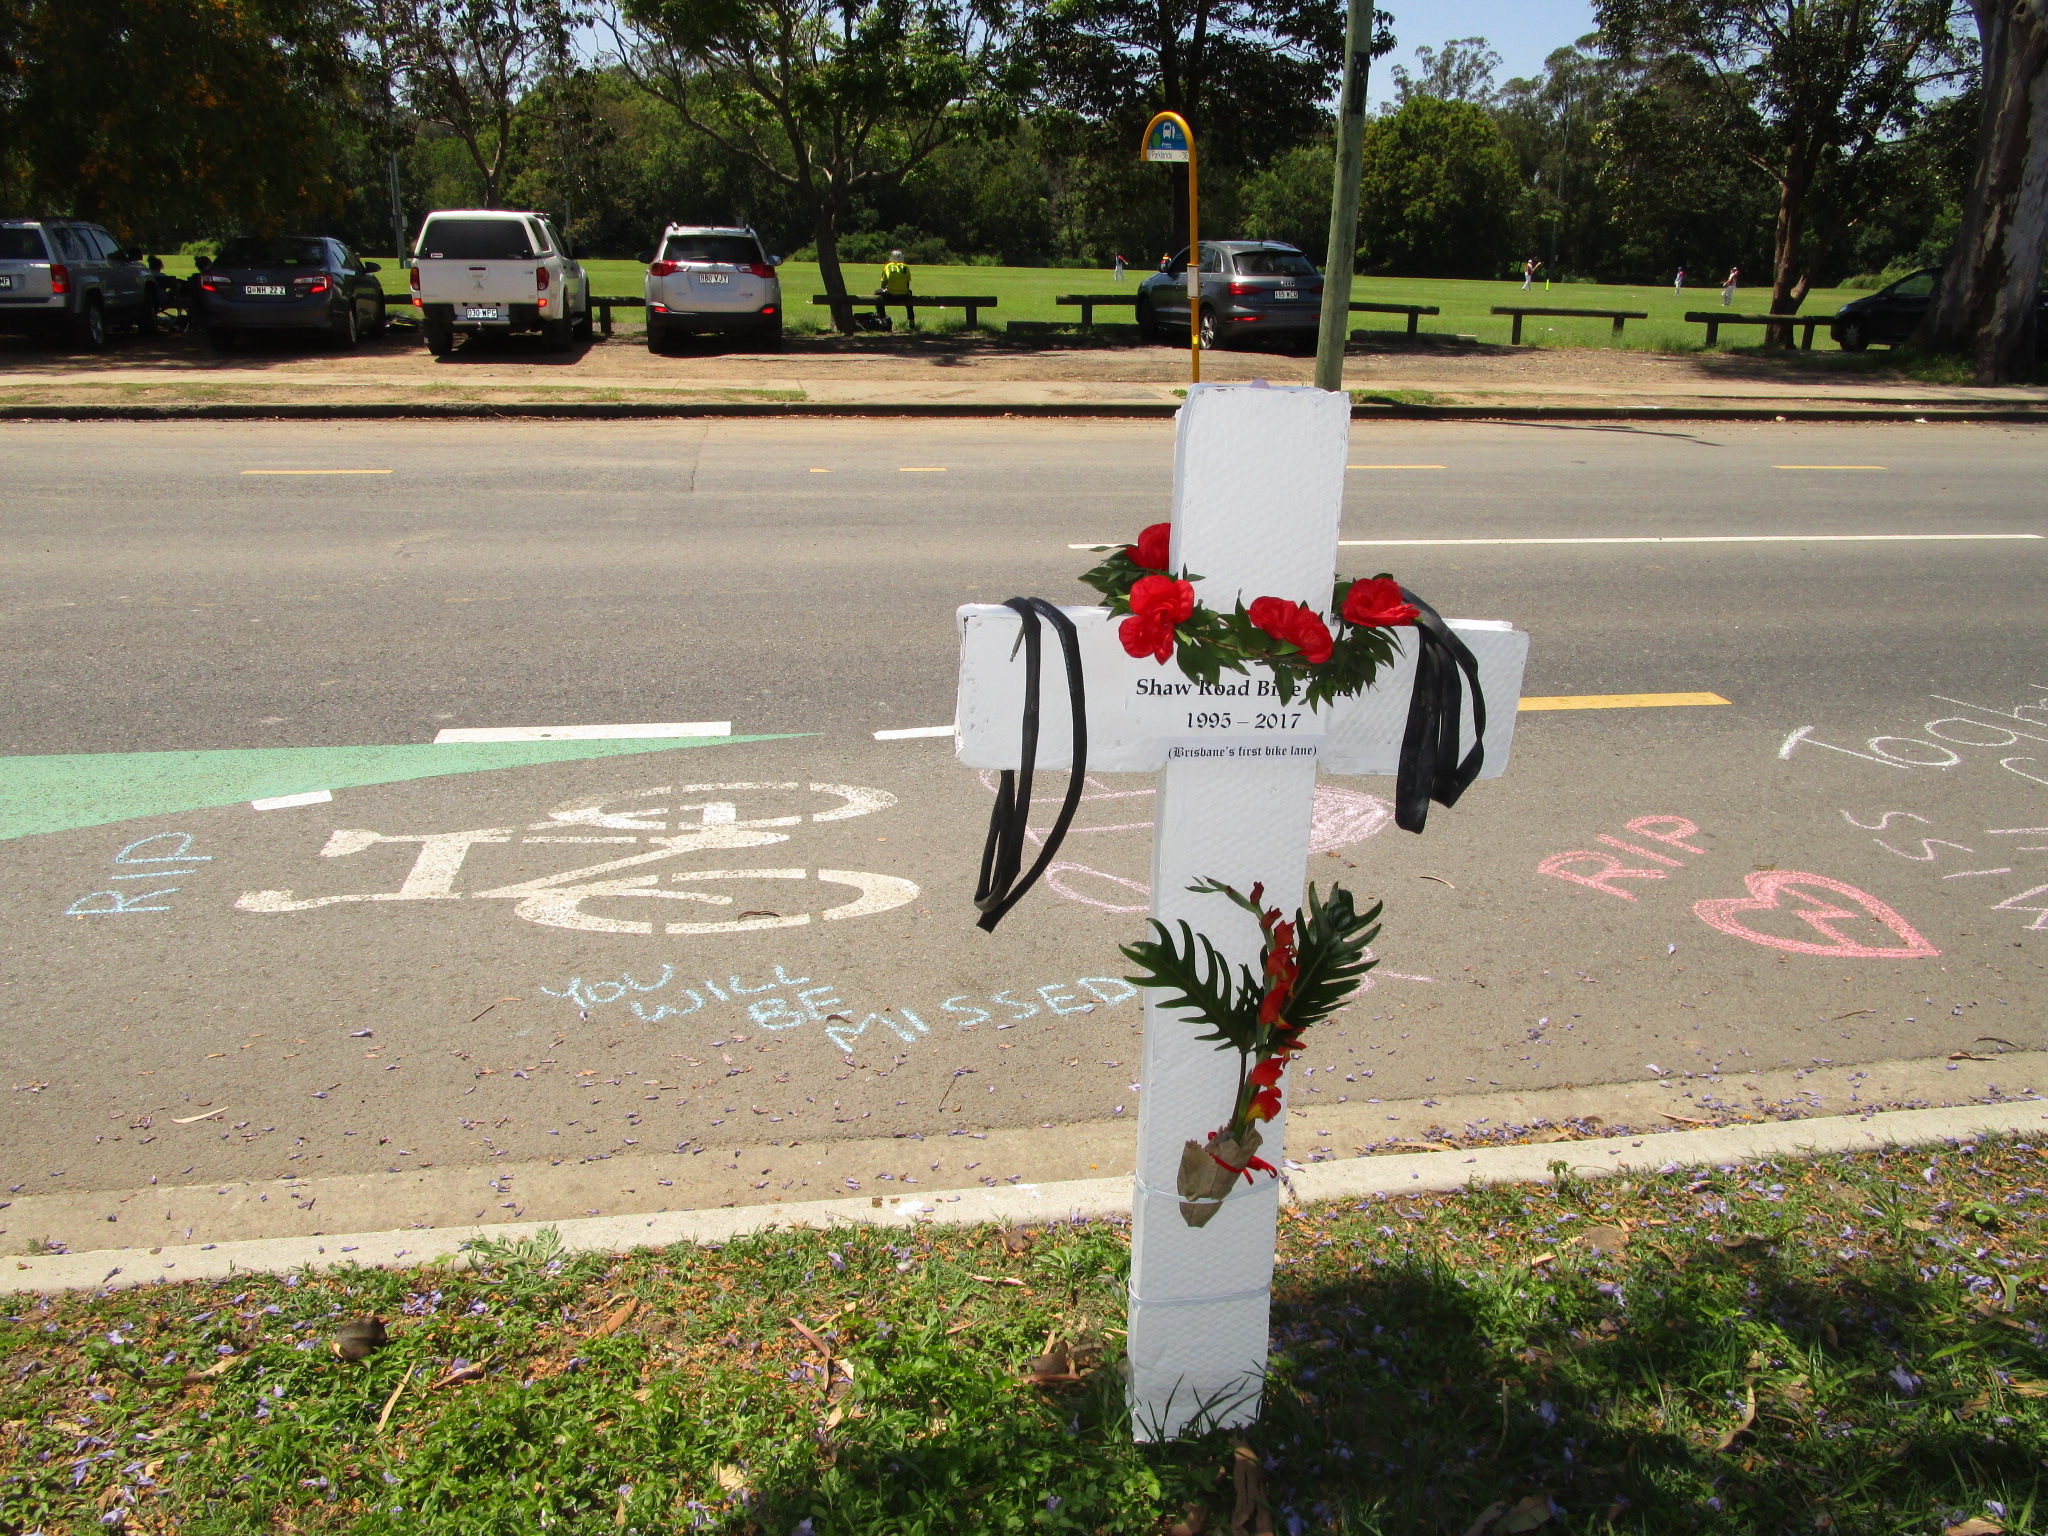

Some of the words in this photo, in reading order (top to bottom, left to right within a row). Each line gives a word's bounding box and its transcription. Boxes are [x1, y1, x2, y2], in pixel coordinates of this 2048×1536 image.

[1152, 150, 1173, 159] Parklands
[1135, 678, 1192, 697] Shaw
[1257, 680, 1302, 697] Bie
[1187, 712, 1232, 730] 1995
[1254, 712, 1302, 730] 2017
[1168, 746, 1236, 759] (Brisbane's
[1238, 746, 1263, 757] first
[1265, 745, 1288, 757] bike
[1290, 745, 1317, 757] lane)
[64, 832, 213, 916] RIP
[1537, 815, 1705, 902] RIP
[541, 964, 674, 1008] YOU
[630, 965, 810, 1022] WILL
[749, 985, 847, 1032] BE
[825, 977, 1138, 1053] MISSED
